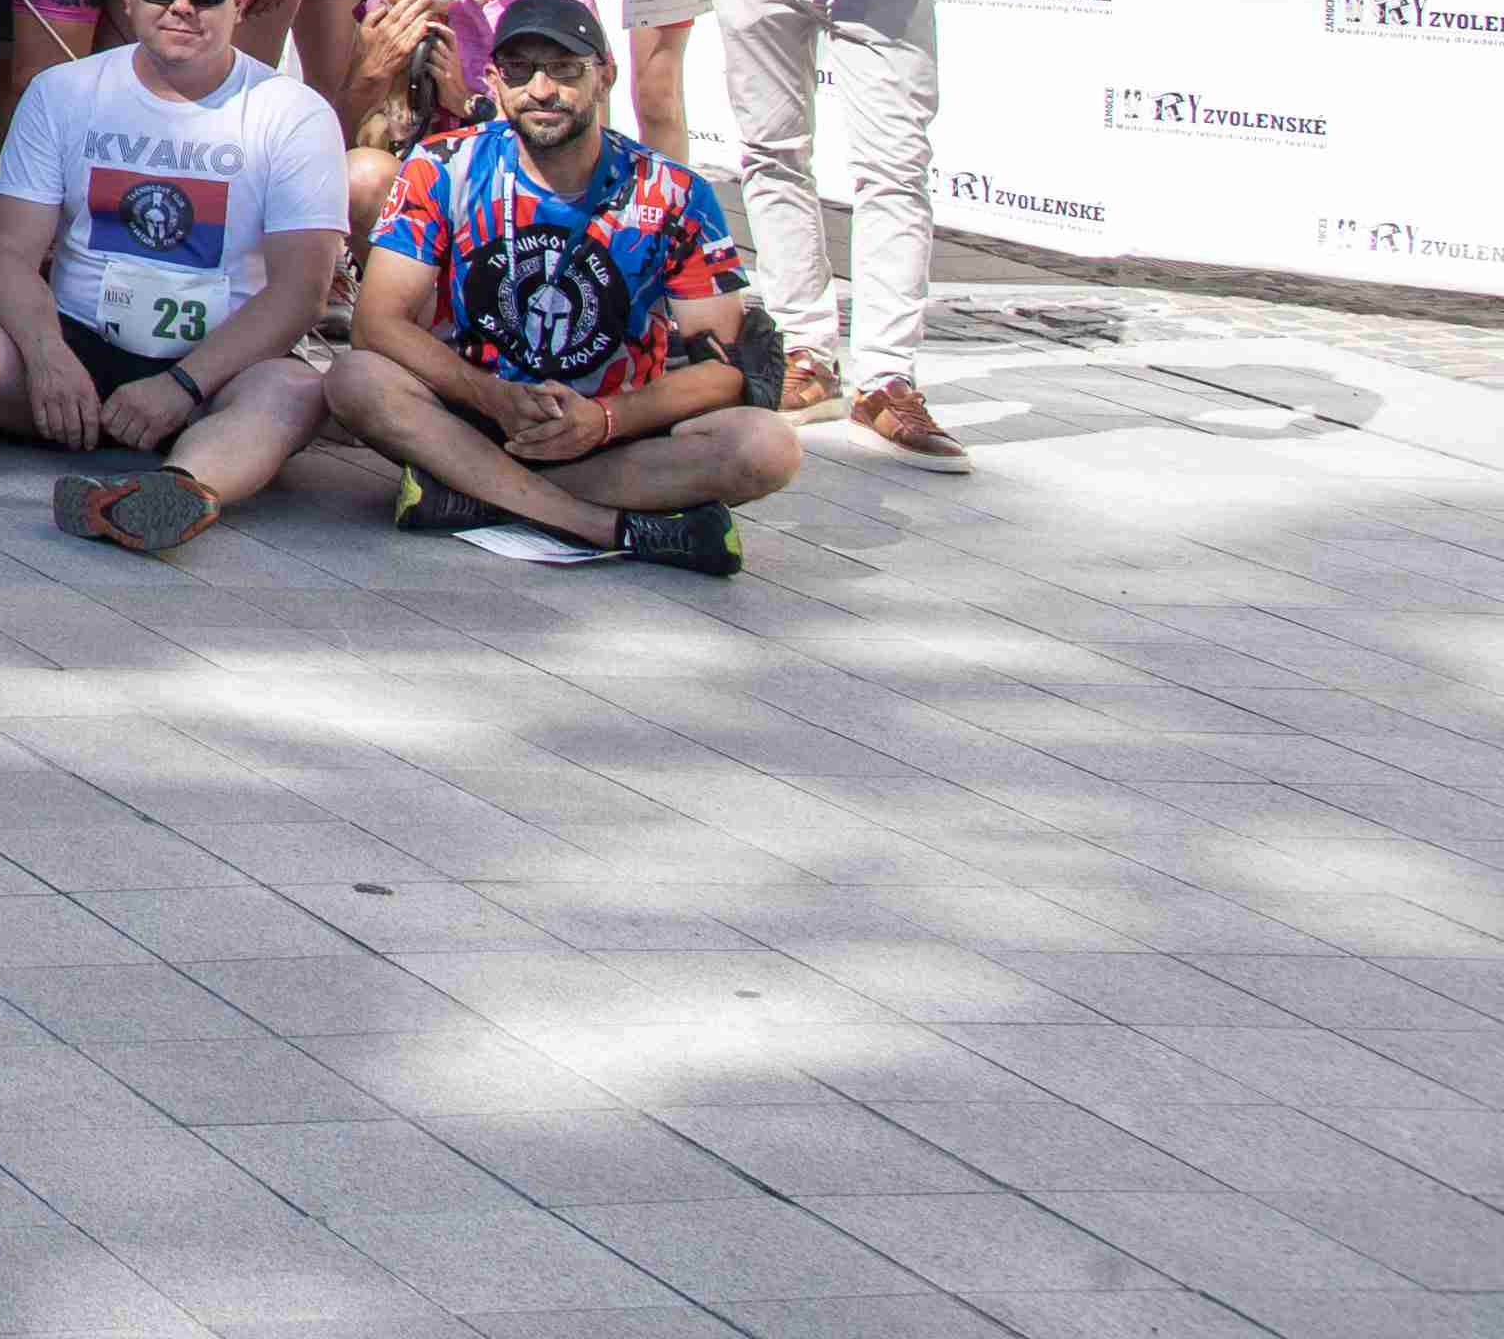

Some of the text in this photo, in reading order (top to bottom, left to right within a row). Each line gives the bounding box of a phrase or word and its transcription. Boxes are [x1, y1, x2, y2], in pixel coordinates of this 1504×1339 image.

[1204, 108, 1327, 136] ZVOLENSKÉ
[82, 129, 245, 176] KVAKO
[995, 189, 1105, 222] ZVOLENSKÉ
[151, 297, 207, 342] 23
[559, 331, 612, 370] ZVOLEN
